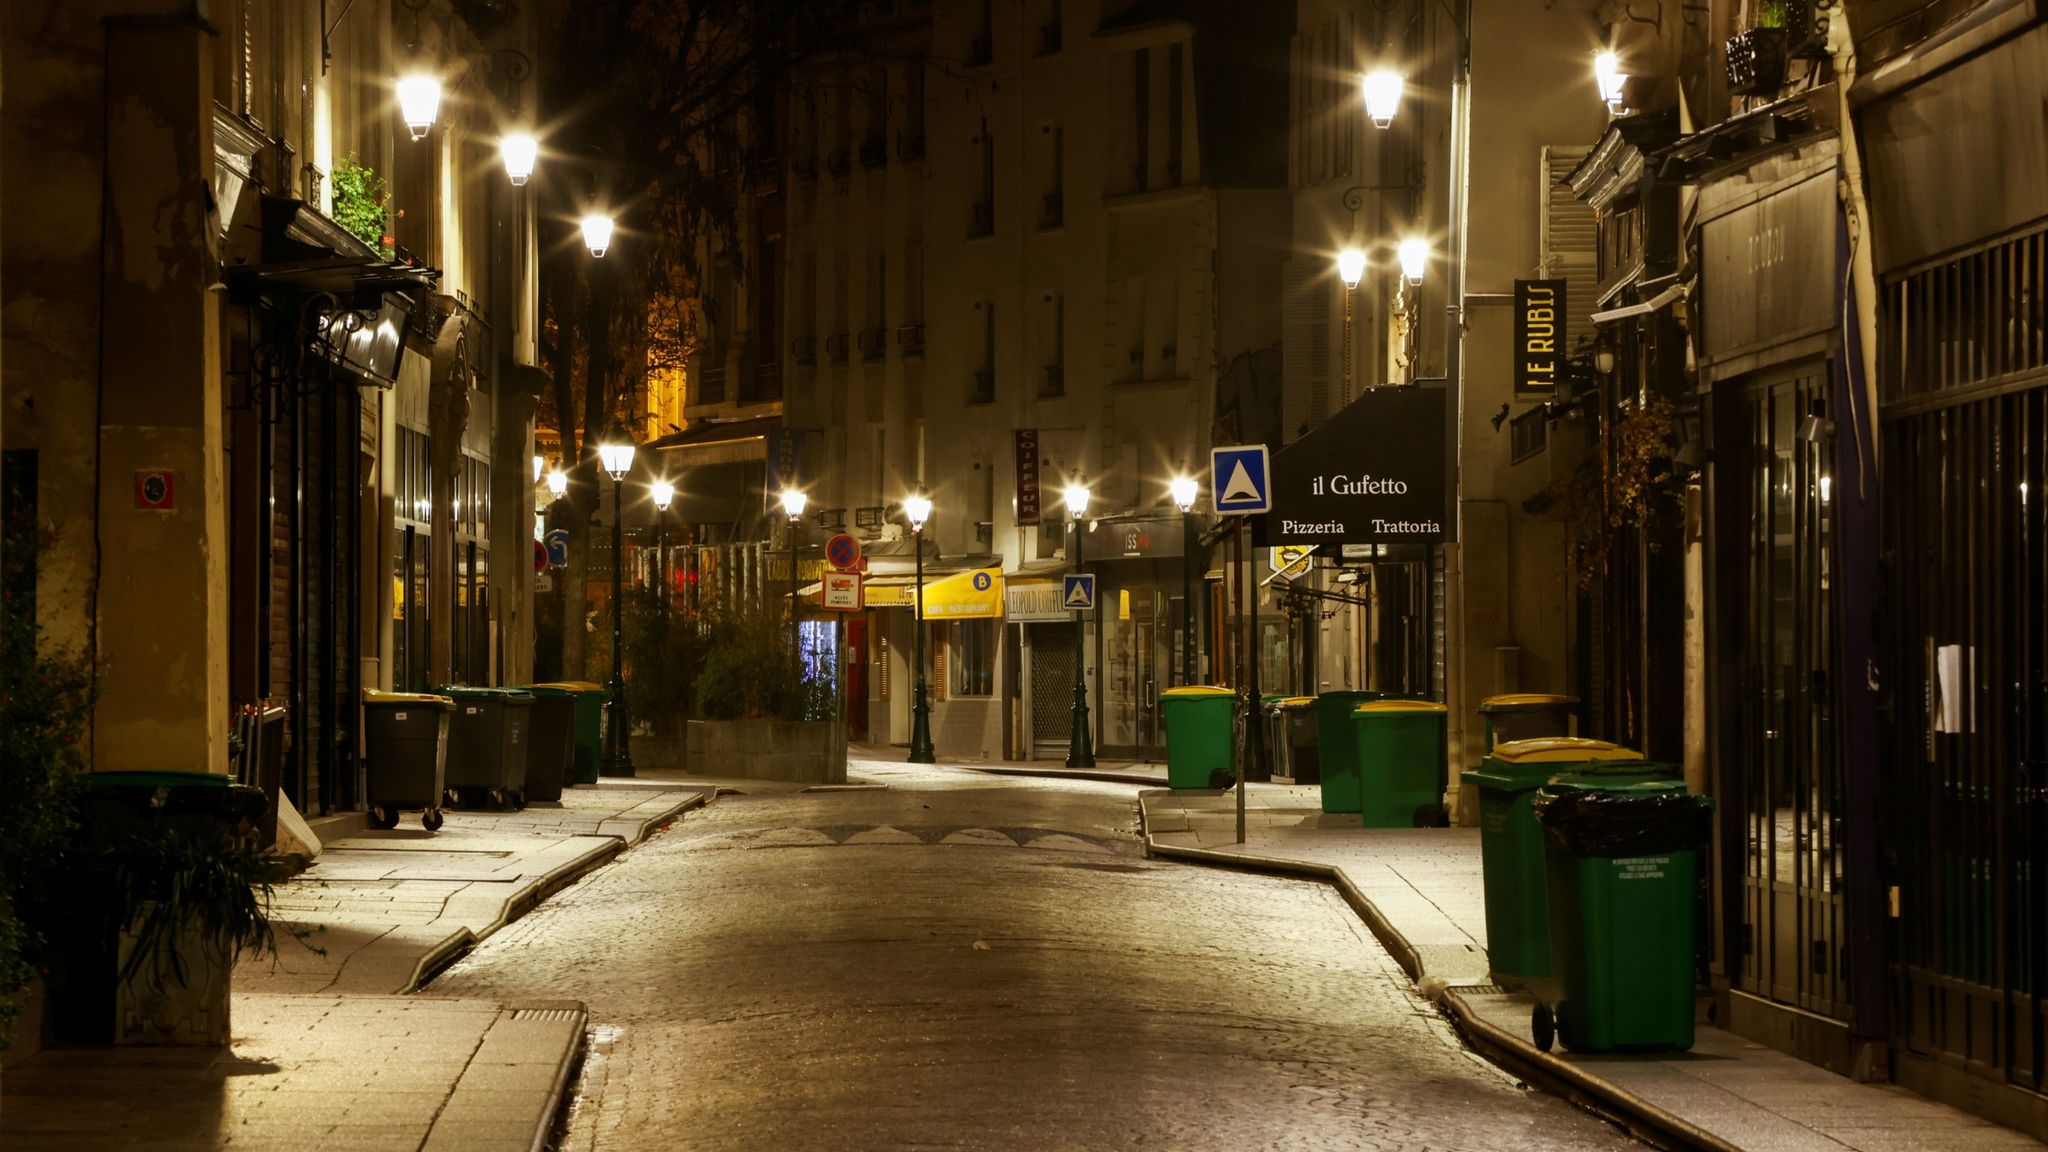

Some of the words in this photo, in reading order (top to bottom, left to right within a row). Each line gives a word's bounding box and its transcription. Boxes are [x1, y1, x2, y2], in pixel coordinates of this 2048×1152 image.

[1527, 285, 1555, 352] RUBIS
[1527, 361, 1555, 386] LE
[1020, 431, 1035, 512] COIFFEUR
[1313, 476, 1324, 495] il
[1330, 474, 1407, 495] Gufetto
[1281, 520, 1344, 534] Pizzeria
[1371, 519, 1441, 533] Trattoria
[979, 575, 988, 588] B
